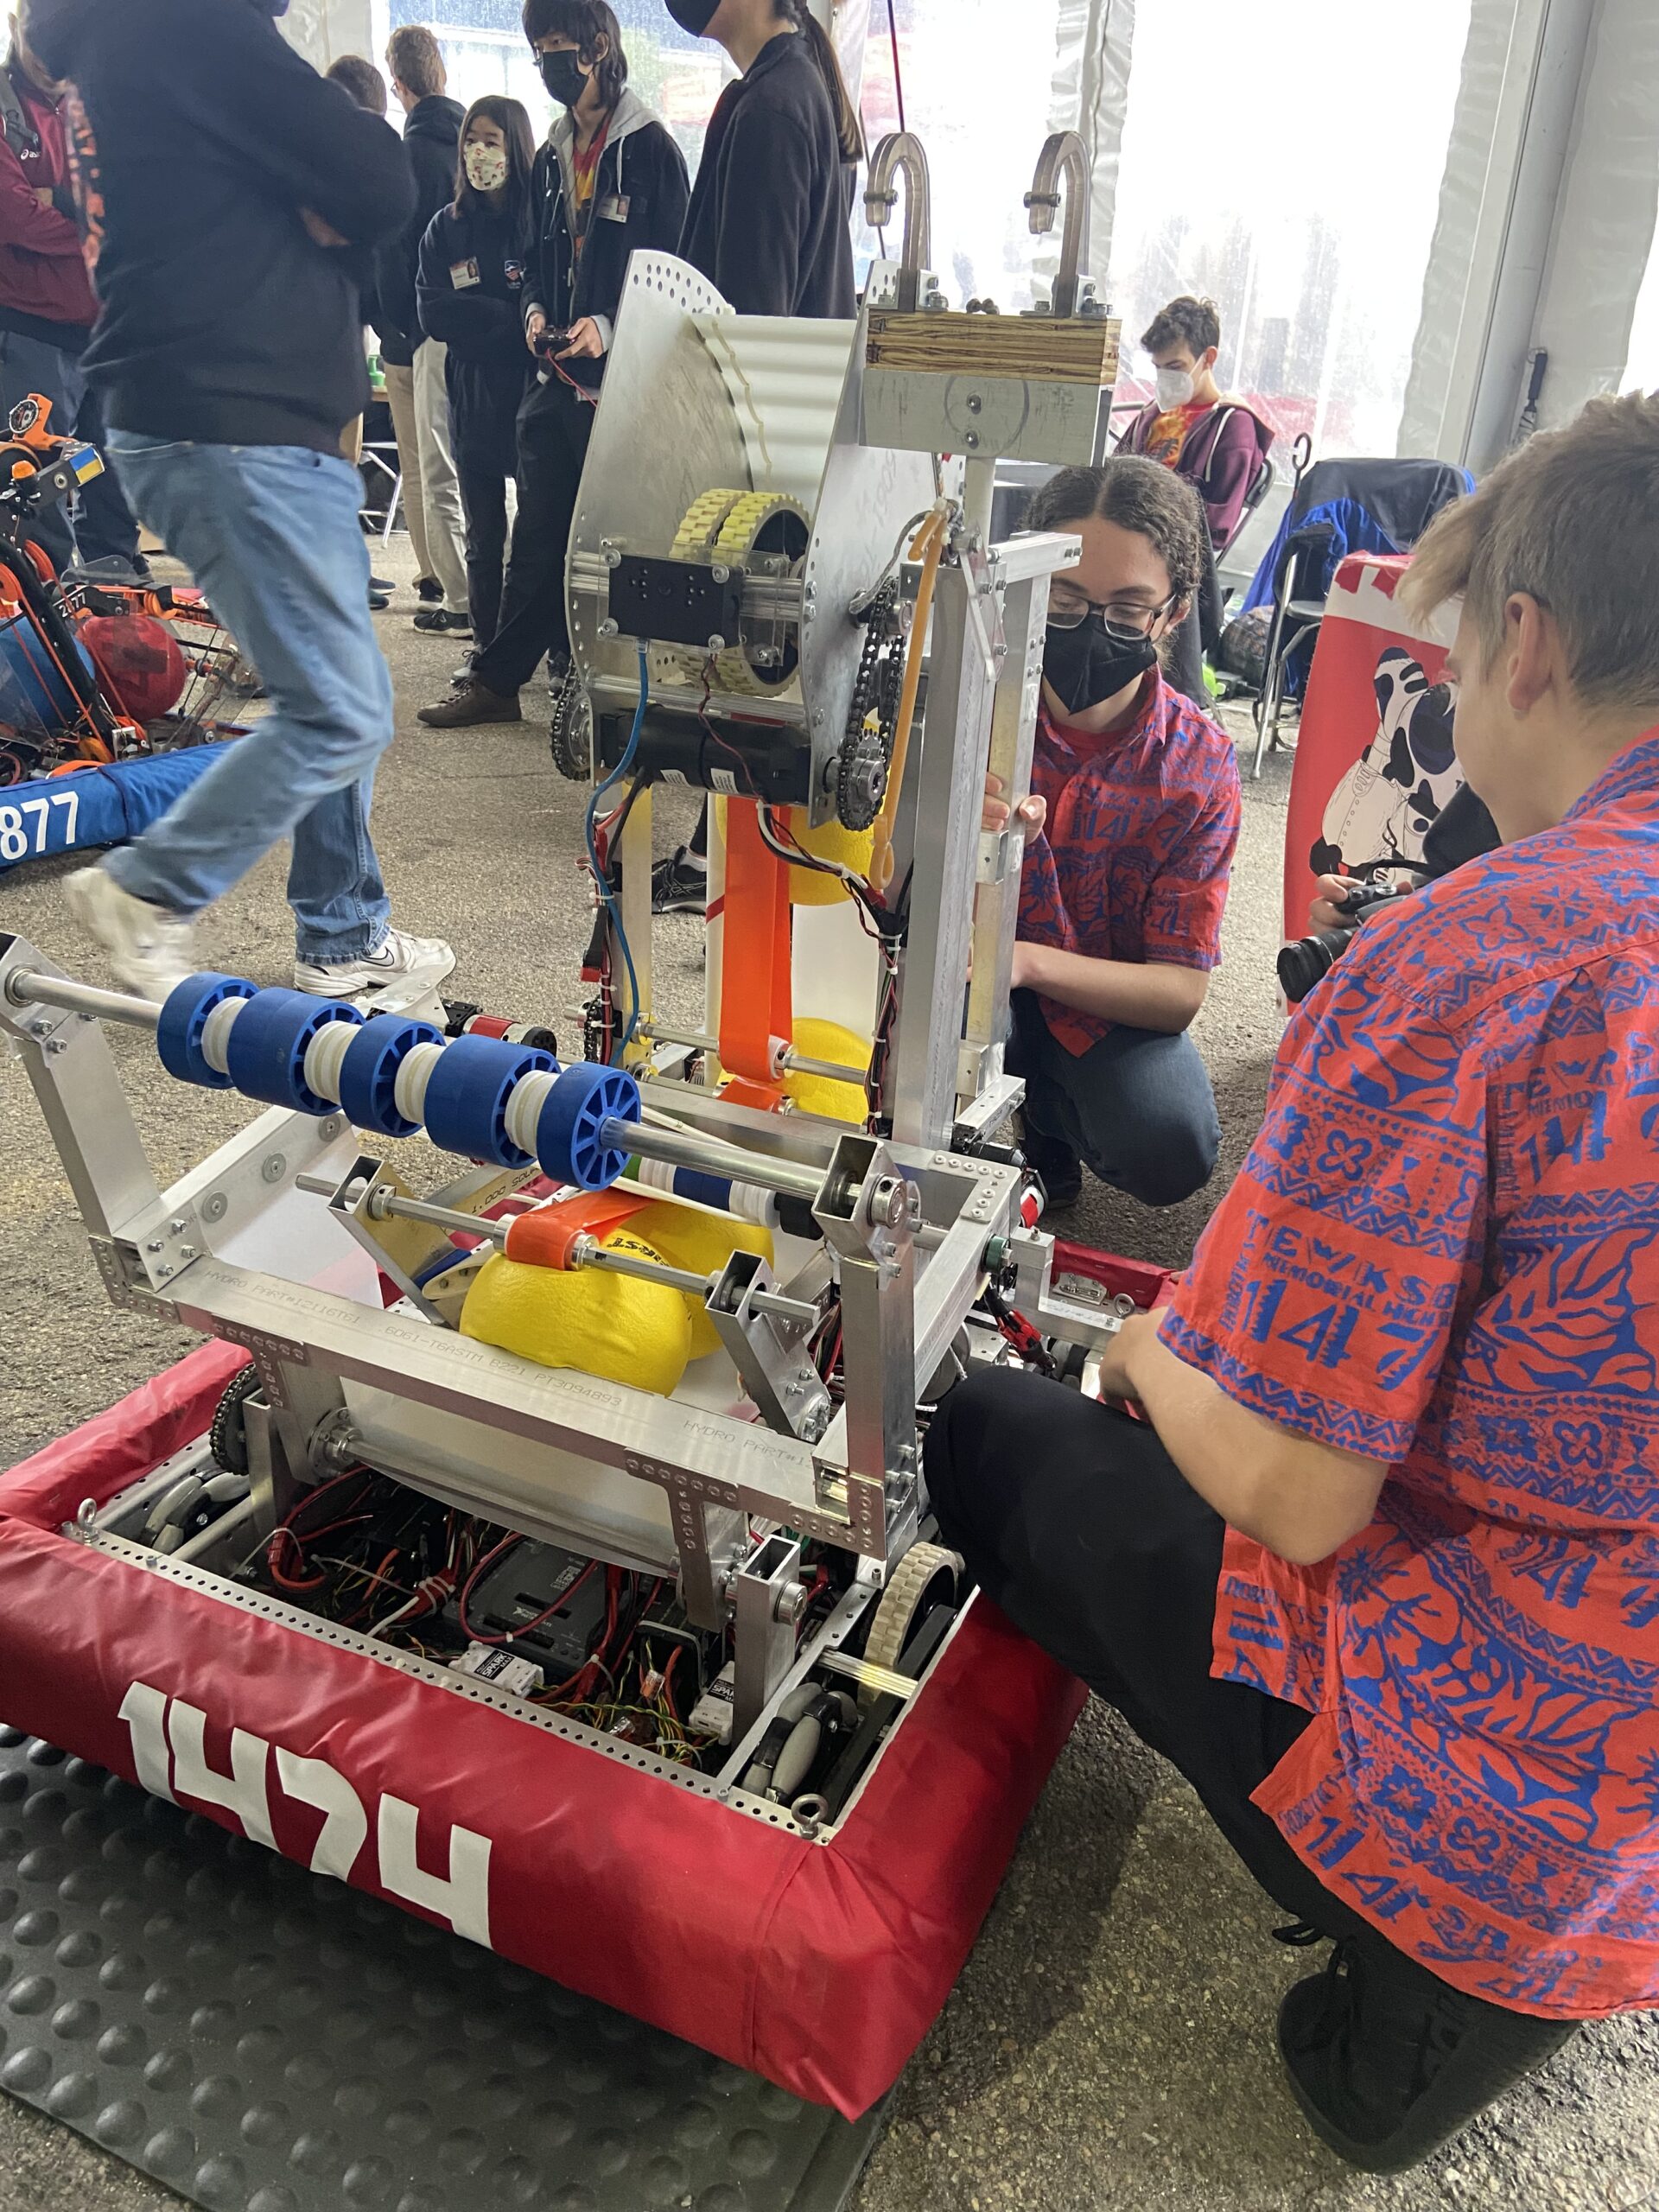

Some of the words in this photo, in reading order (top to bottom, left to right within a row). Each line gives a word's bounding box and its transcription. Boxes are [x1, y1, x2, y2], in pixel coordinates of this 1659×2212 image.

[0, 791, 79, 860] 877
[204, 1270, 249, 1288] HYDRO
[489, 1357, 525, 1376] B221
[683, 1420, 736, 1443] HYDRO
[743, 1439, 812, 1468] PART#1
[482, 1653, 507, 1677] SPARK
[500, 1656, 512, 1668] MAX
[117, 1681, 493, 1950] 1474
